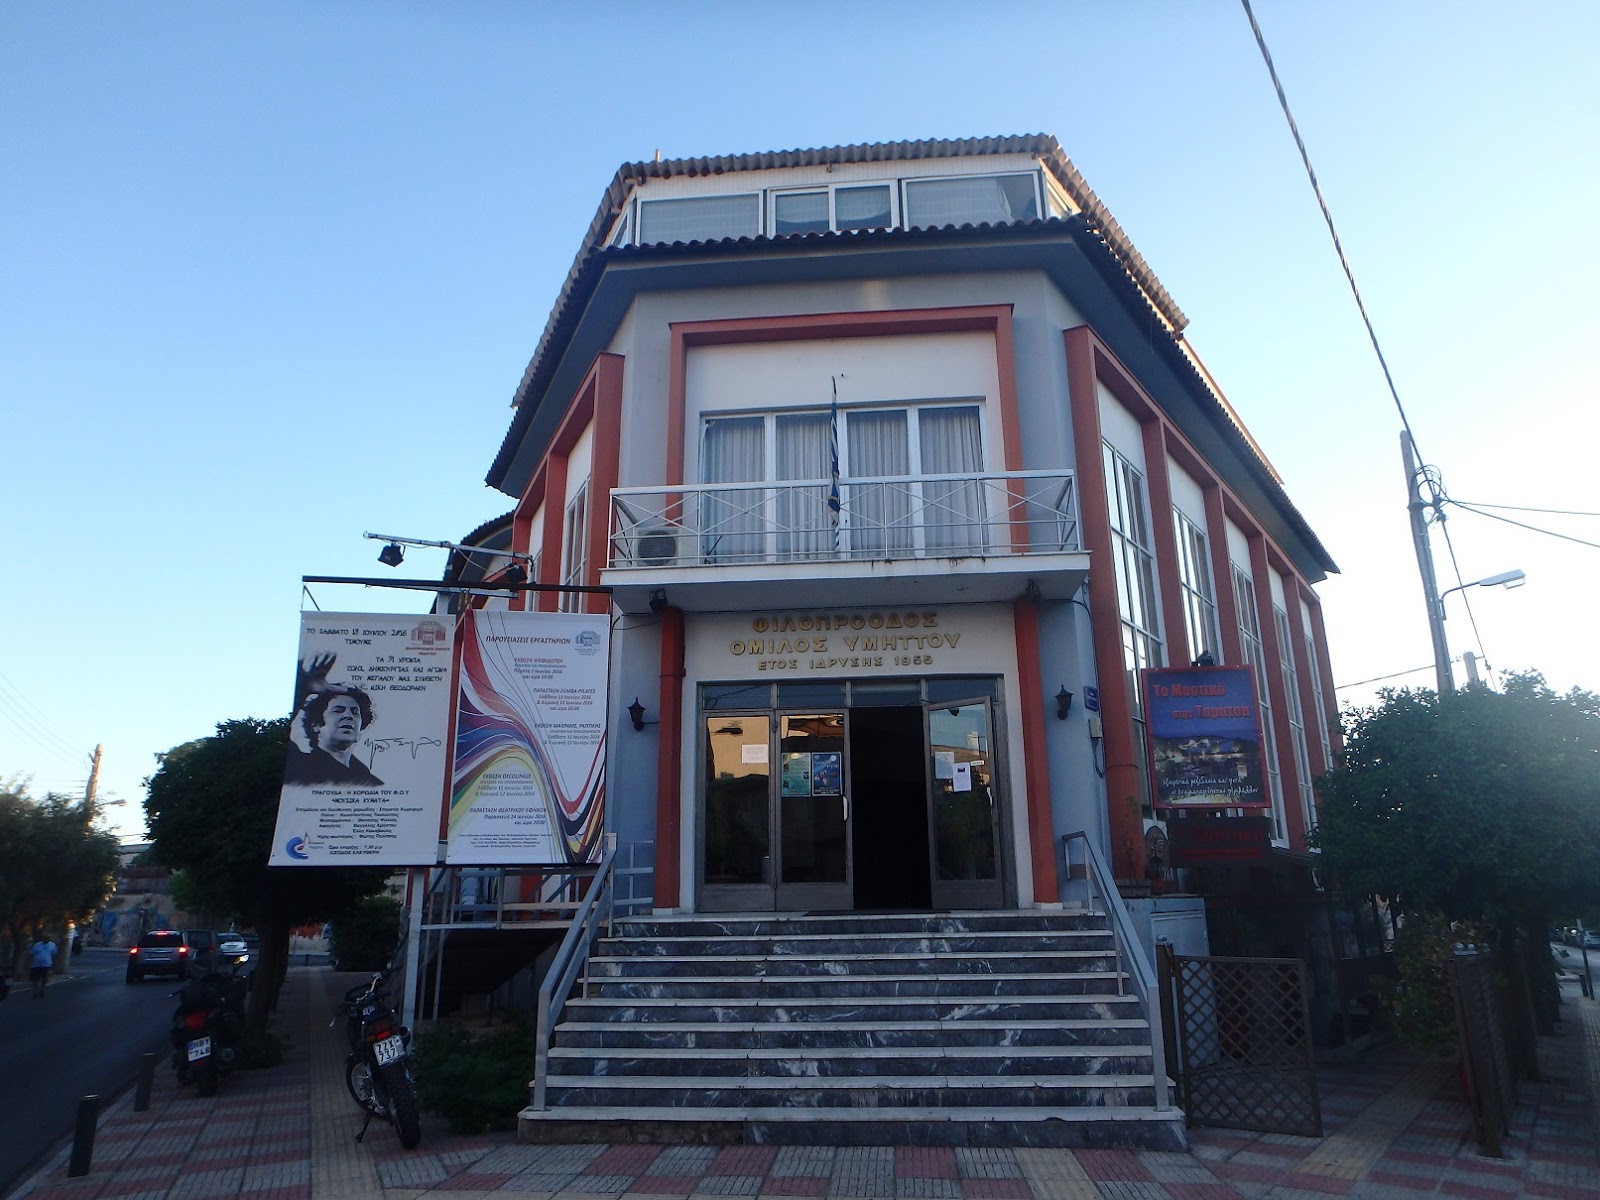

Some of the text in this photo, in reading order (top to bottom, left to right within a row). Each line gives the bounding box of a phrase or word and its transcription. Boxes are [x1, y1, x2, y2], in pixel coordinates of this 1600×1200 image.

[753, 611, 938, 633] ΦΙΛΟΠΡΟΟΔΟΣ
[485, 635, 571, 645] ΠΑΡΟΥΣΙΑΣΕΙΣ ΕΡΓΑΣΤΗΡΙΩΝ
[730, 632, 961, 656] ΟΜΙΛΟΣ ΥΜΗΤΤΟΥ
[758, 655, 934, 670] ΕΤΟΣ ΙΔΡΥΣΗΣ 1955
[1153, 683, 1226, 697] Το Μυστικό
